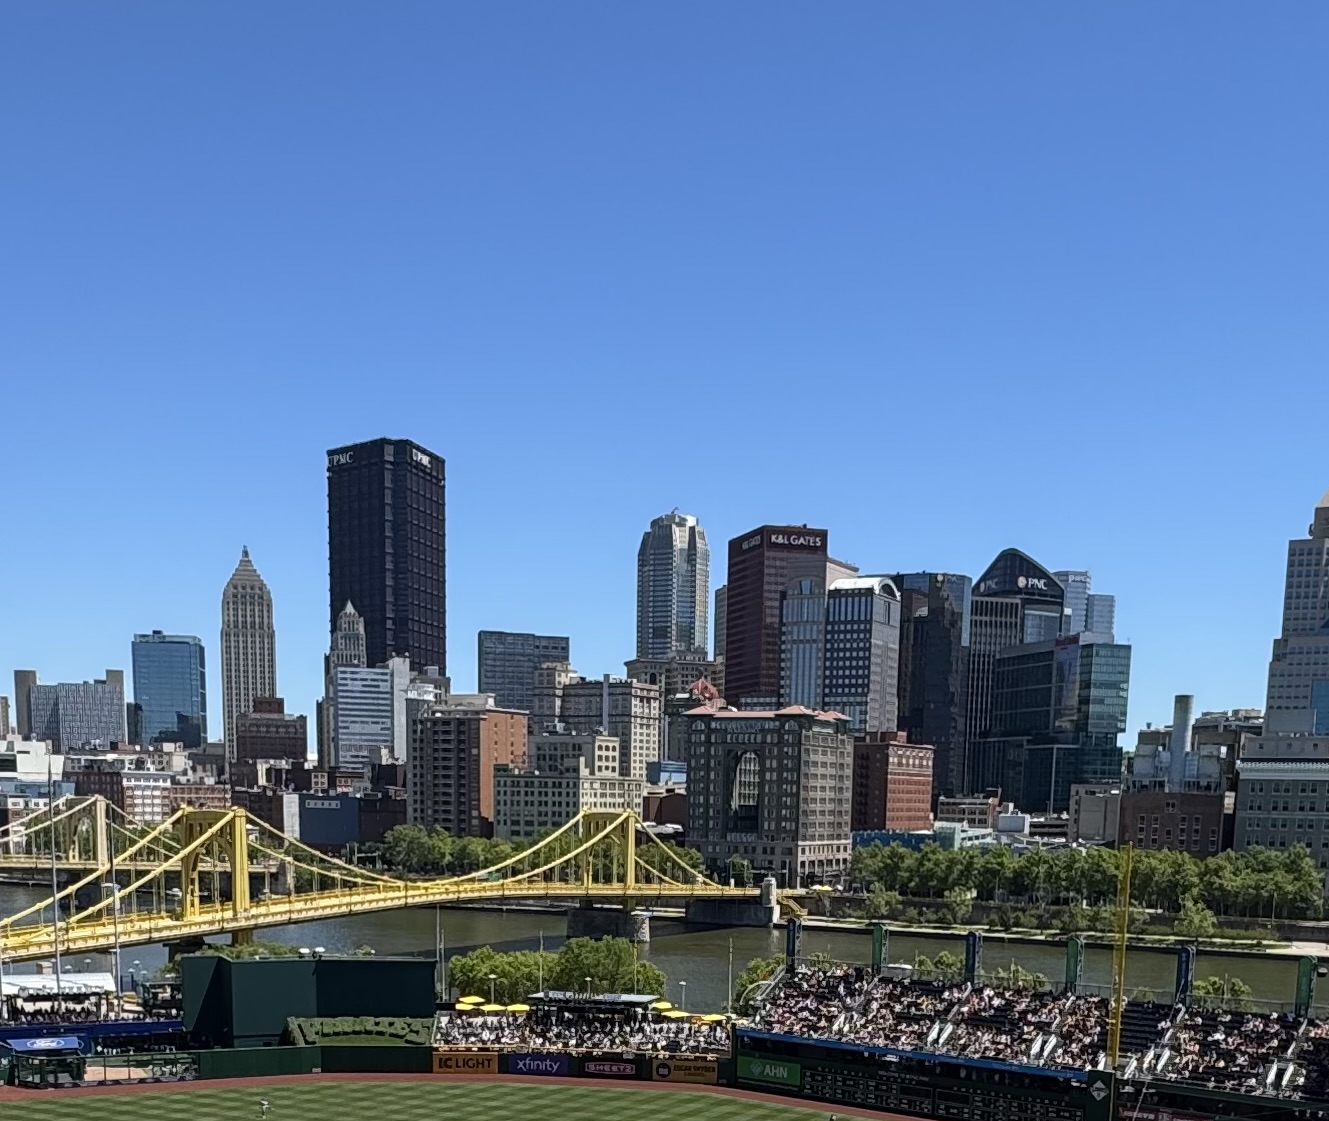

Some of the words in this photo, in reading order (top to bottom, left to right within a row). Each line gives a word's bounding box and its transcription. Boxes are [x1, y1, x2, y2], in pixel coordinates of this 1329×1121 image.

[327, 451, 354, 467] UPMC
[412, 448, 432, 468] UPMC
[771, 534, 789, 544] K&L
[790, 535, 822, 546] GATES
[1028, 578, 1048, 590] PNC
[455, 1057, 493, 1069] LIGHT
[516, 1058, 561, 1073] xfinity
[764, 1064, 788, 1079] AHN
